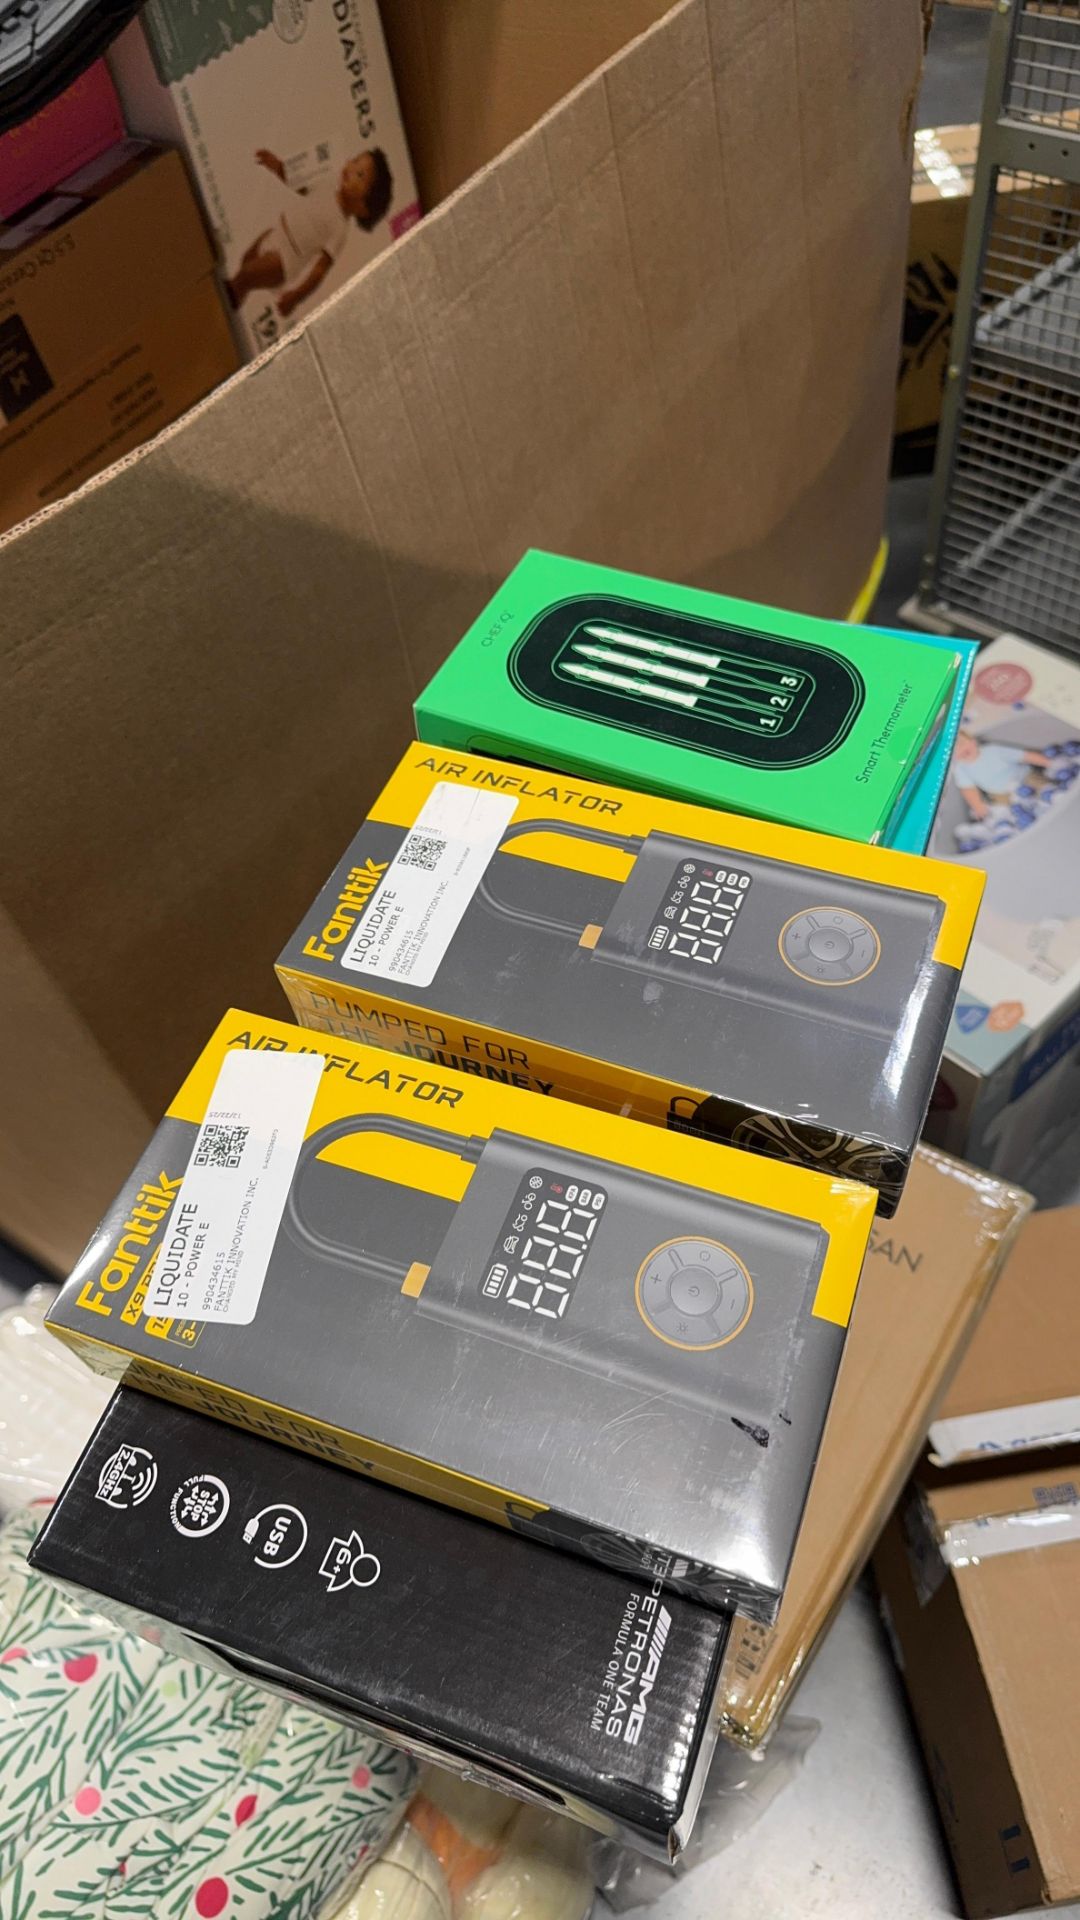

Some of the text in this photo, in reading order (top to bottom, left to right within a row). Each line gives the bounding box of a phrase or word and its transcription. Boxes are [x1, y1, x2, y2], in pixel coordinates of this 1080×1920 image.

[333, 0, 377, 139] DIAPERS
[769, 695, 789, 708] 2
[780, 675, 798, 687] 3
[759, 717, 777, 728] 1
[855, 683, 913, 784] Smart Thermometer
[414, 757, 624, 816] AIR INFLATOR
[302, 857, 390, 962] Fanttik
[350, 890, 397, 963] LIQUIDATE
[368, 954, 380, 967] 10
[378, 913, 401, 947] POWER
[395, 905, 404, 914] E
[413, 895, 441, 941] INNOVATION
[311, 991, 530, 1070] PUMPED FOR
[319, 1015, 555, 1096] THE JOURNEY
[75, 1170, 185, 1317] Fanttik
[153, 1203, 199, 1306] LIQUIDATE
[177, 1292, 189, 1308] 10
[185, 1233, 207, 1278] POWER
[198, 1222, 210, 1230] E
[214, 1176, 260, 1312] FANTTIK INNOVATION INC.
[126, 1291, 146, 1318] X9
[202, 1251, 226, 1311] 990434615
[194, 1400, 375, 1472] JOURNEY
[262, 1410, 343, 1450] FOR
[100, 1450, 131, 1498] 2.4GHz
[169, 1474, 205, 1530] FULL FUNCTION
[190, 1489, 211, 1522] STOP
[263, 1516, 292, 1557] USB
[332, 1547, 352, 1574] 6+
[590, 1592, 640, 1732] FORMULA ONE TEAM
[624, 1646, 660, 1746] AMG
